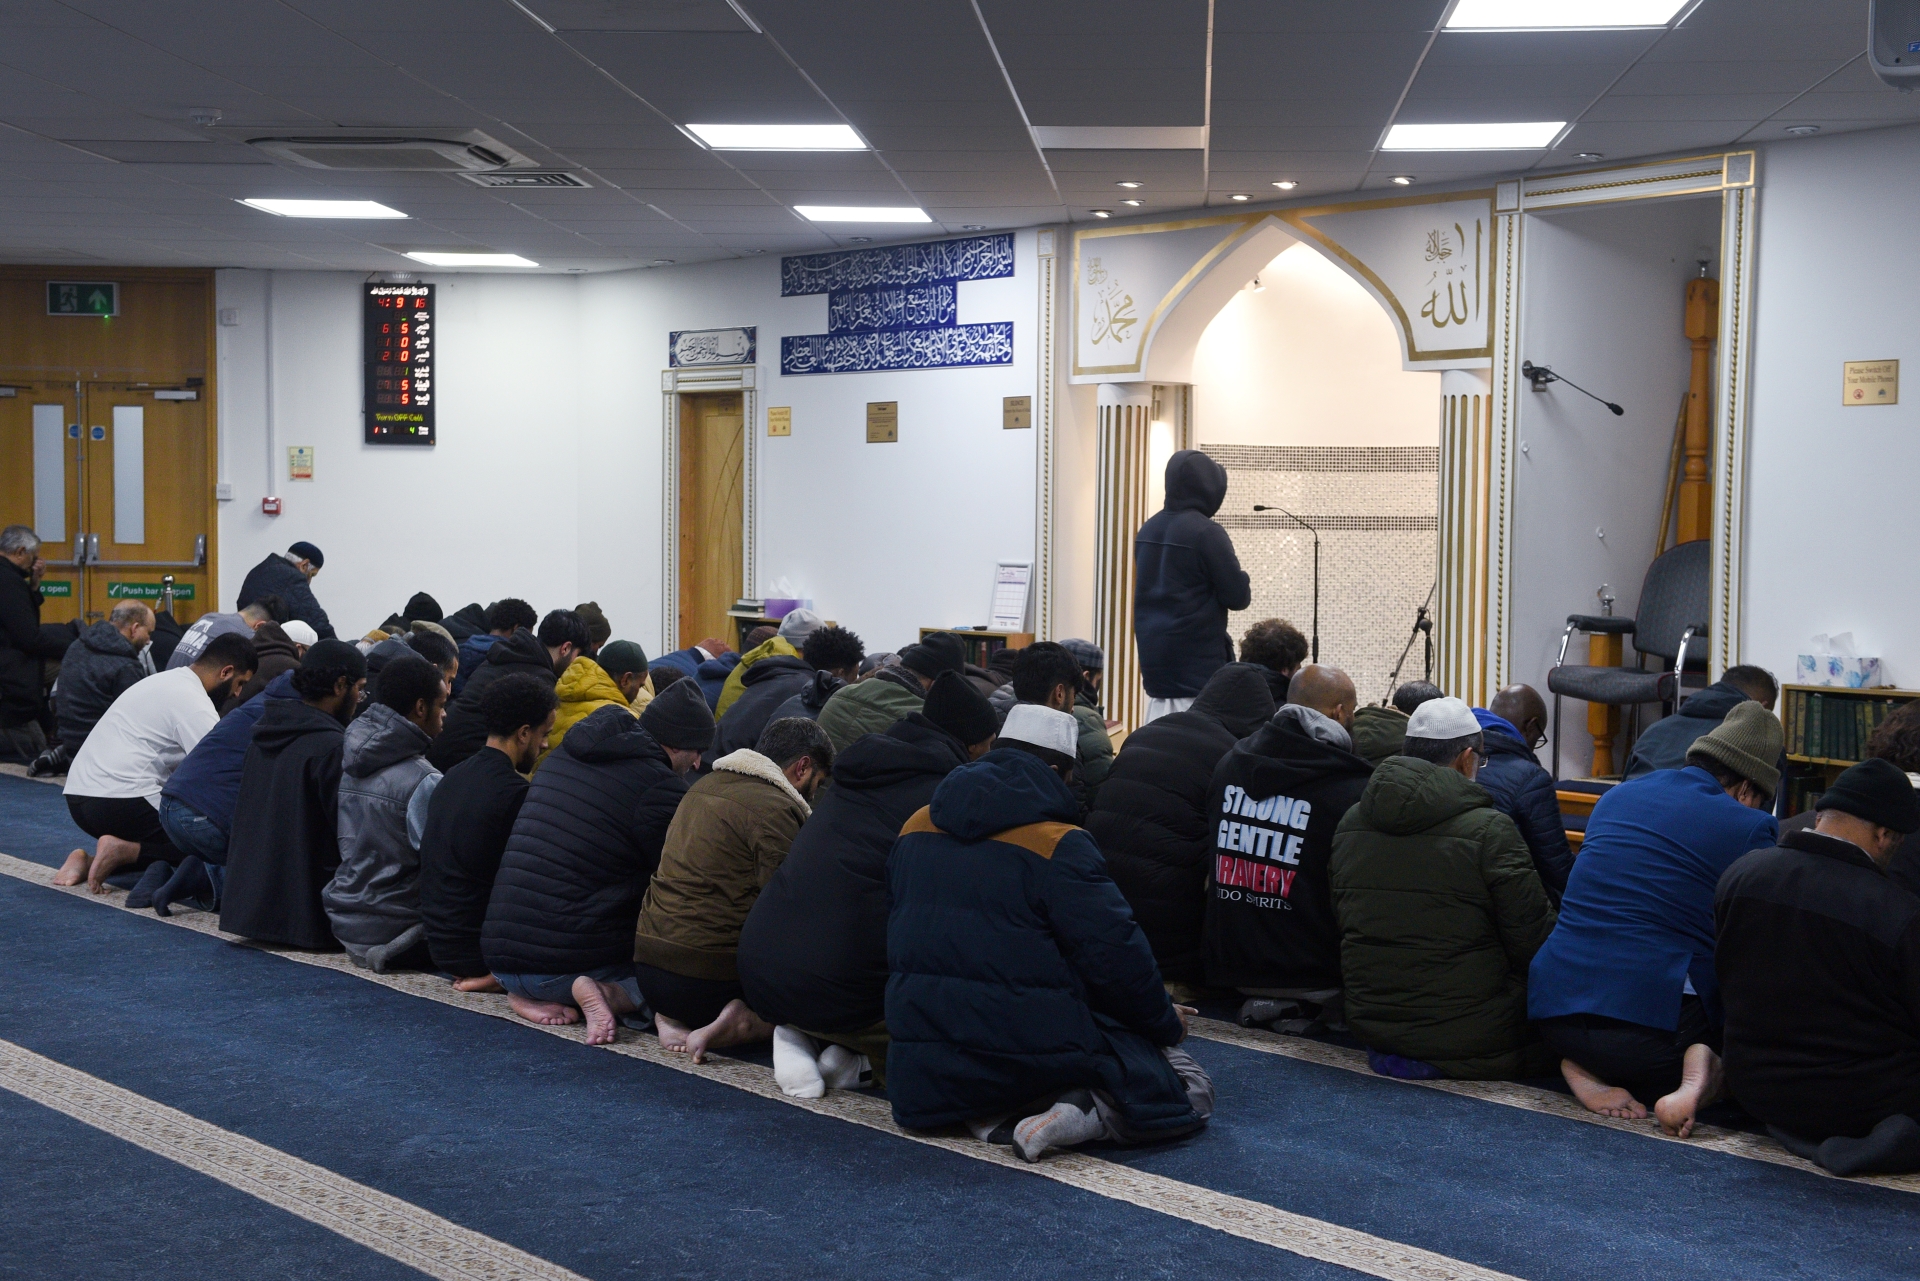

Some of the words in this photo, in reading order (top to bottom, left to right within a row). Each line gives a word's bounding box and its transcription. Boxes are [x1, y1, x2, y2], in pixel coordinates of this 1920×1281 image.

[47, 585, 68, 594] open
[122, 586, 144, 595] Push
[145, 587, 159, 595] bar
[1217, 819, 1304, 866] GENTLE
[1216, 853, 1297, 899] RAVERY
